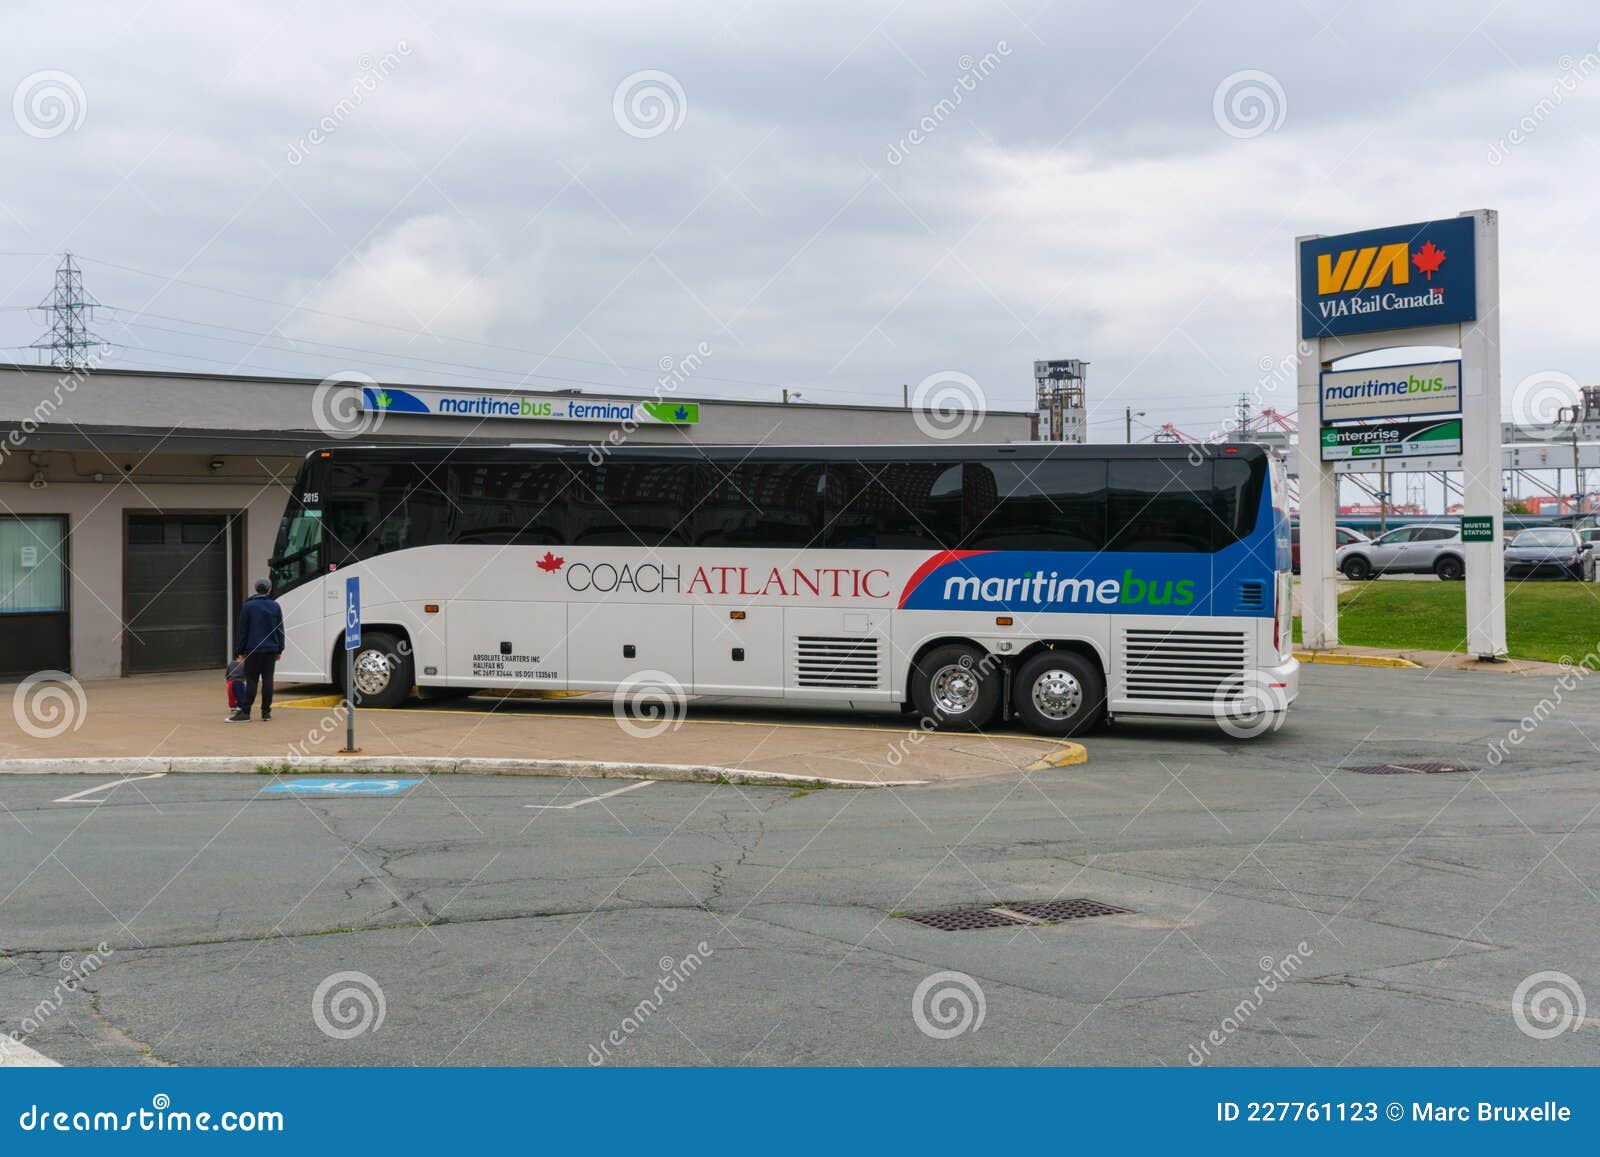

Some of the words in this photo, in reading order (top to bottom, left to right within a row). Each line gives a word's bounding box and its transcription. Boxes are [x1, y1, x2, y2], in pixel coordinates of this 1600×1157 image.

[1317, 242, 1409, 295] VIA
[1319, 300, 1349, 318] VIA
[1351, 295, 1380, 315] Rail
[1382, 288, 1444, 311] Canada
[568, 401, 634, 420] terminal
[1326, 428, 1399, 443] enterprise
[304, 492, 319, 502] 2015
[566, 563, 680, 593] COACH
[687, 565, 890, 599] ATLANTIC
[943, 568, 1195, 606] maritimebus
